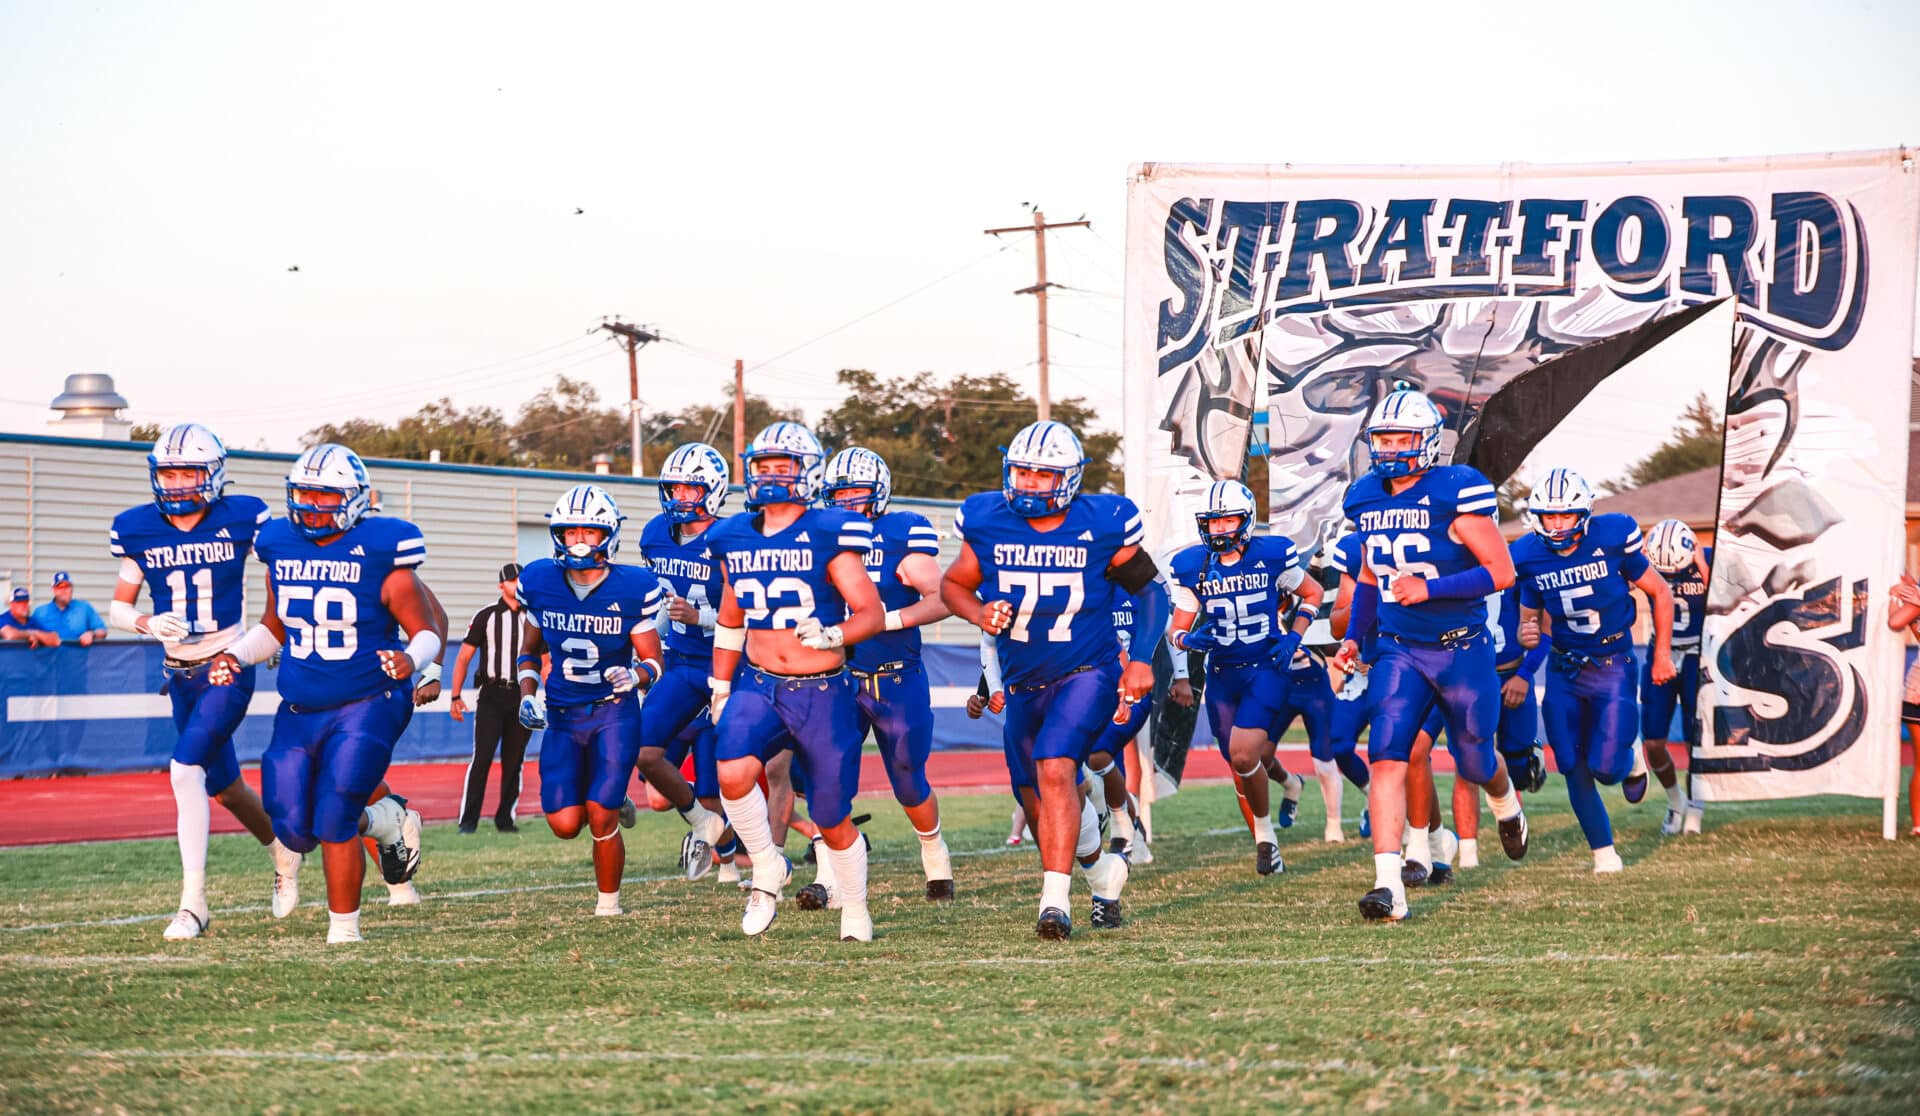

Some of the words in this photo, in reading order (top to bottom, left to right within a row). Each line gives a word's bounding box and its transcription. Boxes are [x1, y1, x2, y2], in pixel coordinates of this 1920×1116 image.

[1158, 193, 1868, 377] STRATFORD
[1360, 508, 1430, 532] STRATFORD
[144, 541, 235, 569] STRATFORD
[275, 559, 361, 584] STRATFORD
[727, 548, 812, 574] STRATFORD
[994, 543, 1087, 568] STRATFORD
[1366, 533, 1439, 603] 66
[1196, 573, 1269, 596] STRATFORD
[1535, 560, 1608, 591] STRATFORD
[166, 568, 218, 635] 11
[998, 570, 1084, 642] 77
[1206, 591, 1269, 646] 35
[1559, 585, 1601, 634] 5
[278, 585, 358, 661] 58
[542, 610, 622, 635] STRATFORD
[560, 637, 602, 684] 2
